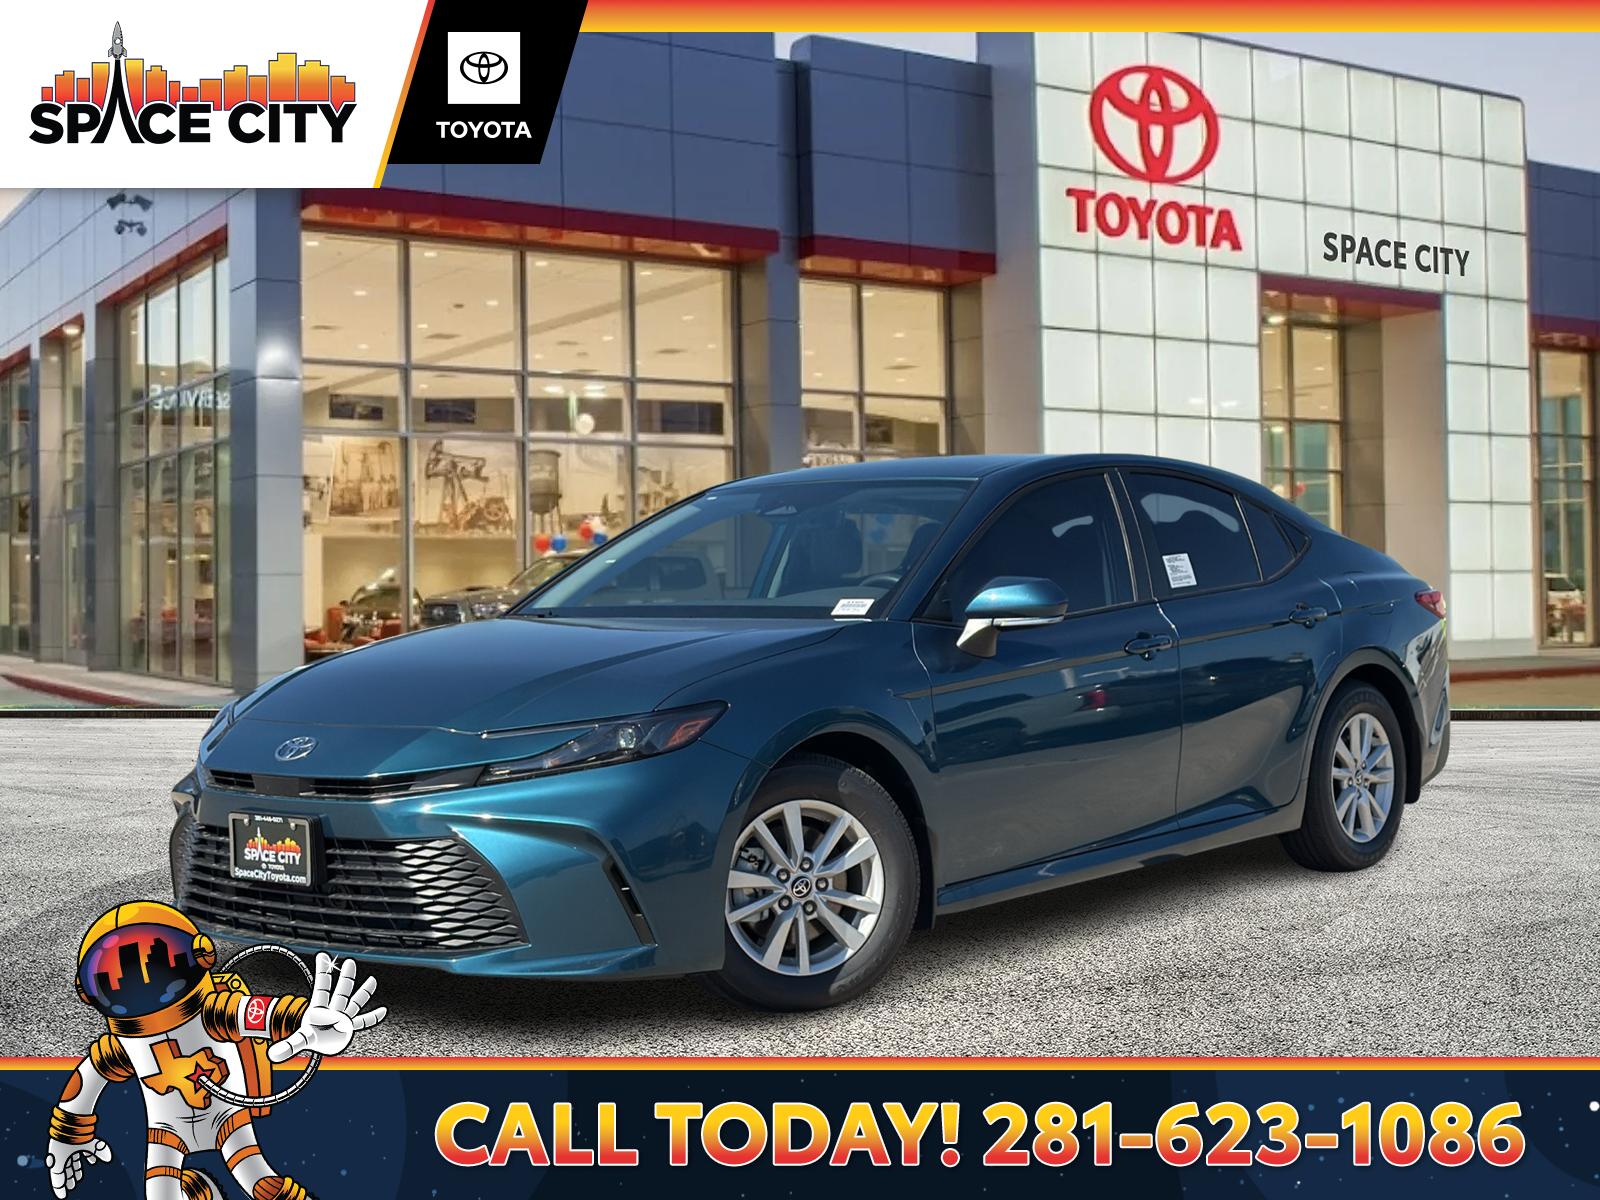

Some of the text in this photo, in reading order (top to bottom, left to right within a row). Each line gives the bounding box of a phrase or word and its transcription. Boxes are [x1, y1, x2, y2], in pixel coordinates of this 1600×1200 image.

[1066, 187, 1242, 251] TOYOTA
[1323, 232, 1470, 277] SPACE CITY
[244, 848, 302, 865] SPACE CITY
[234, 867, 307, 884] SpaceCityToyota.com
